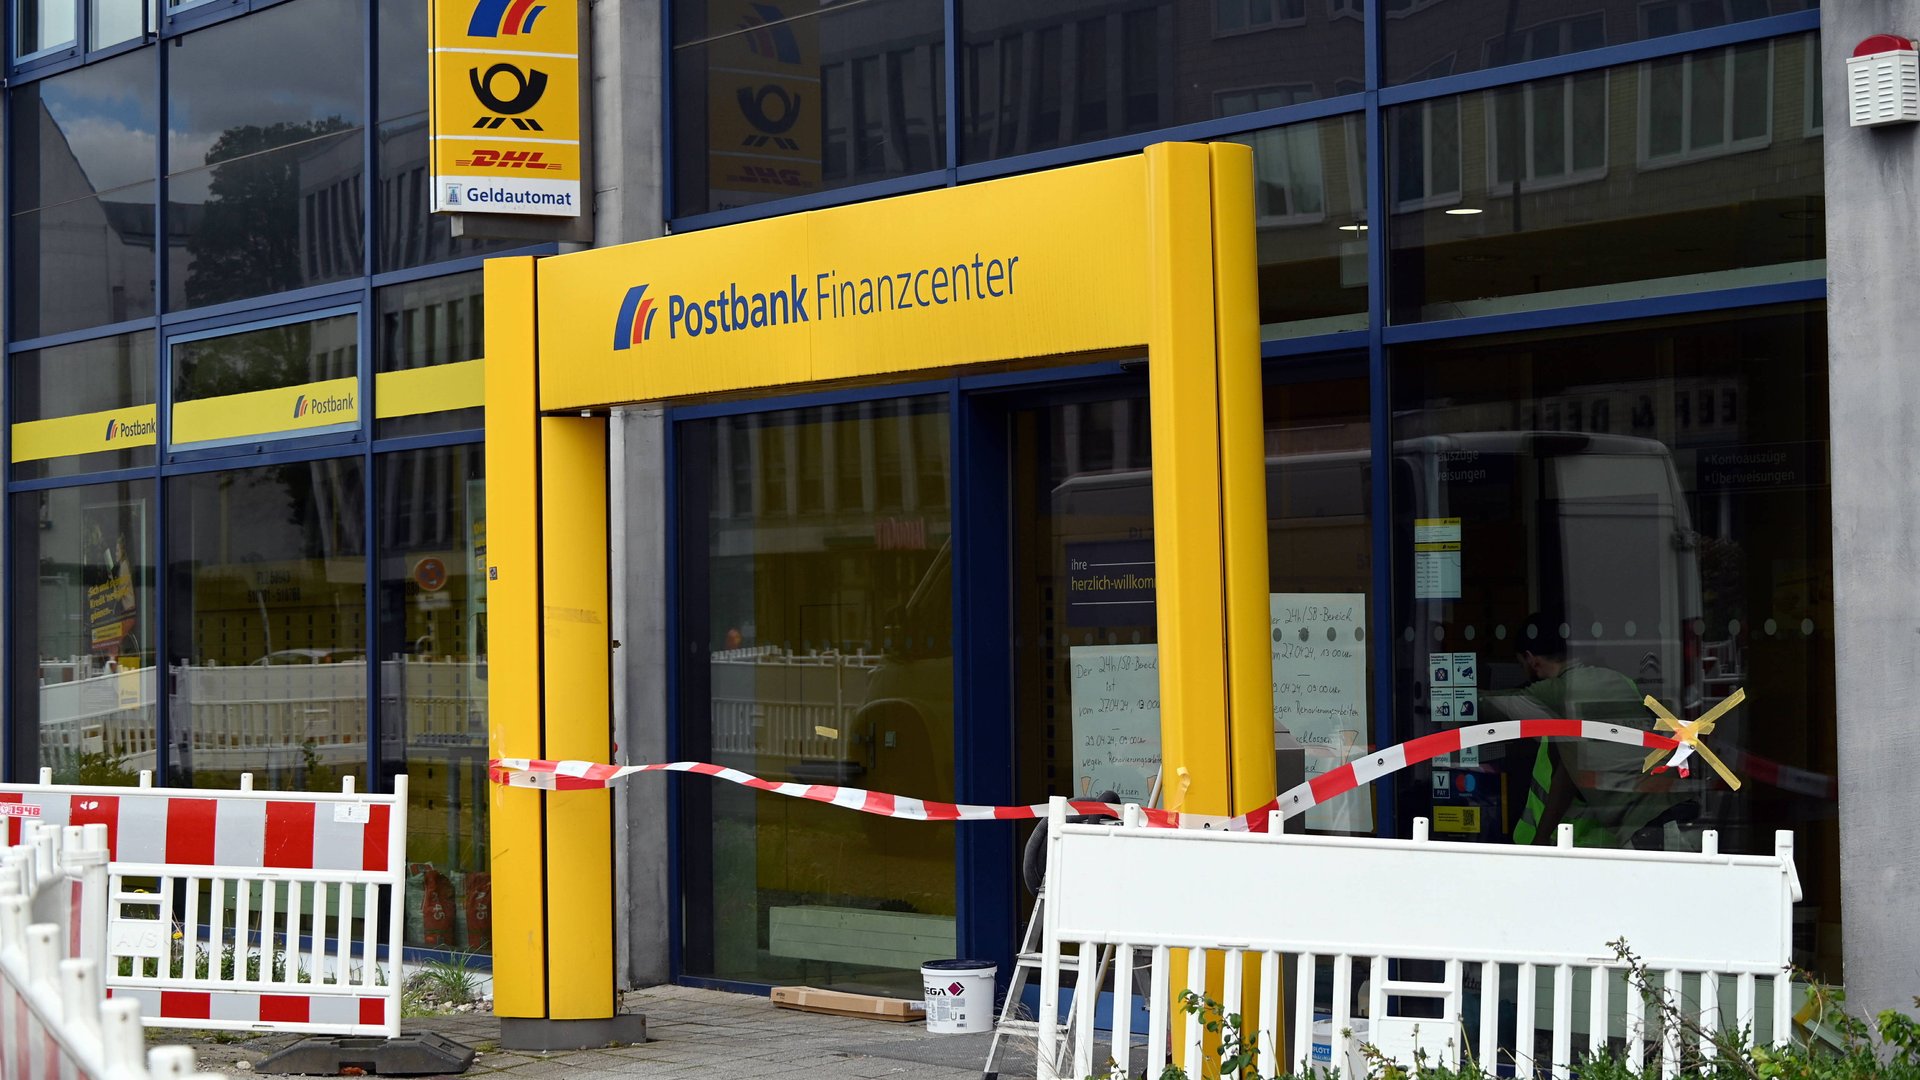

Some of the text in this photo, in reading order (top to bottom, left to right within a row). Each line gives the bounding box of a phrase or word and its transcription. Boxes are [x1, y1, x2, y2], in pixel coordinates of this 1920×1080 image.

[470, 150, 549, 169] DHL
[467, 188, 572, 205] Geldautomat
[669, 253, 1019, 339] Postbank Finanzcenter
[311, 393, 354, 415] Postbank
[119, 418, 156, 437] Postbank
[1071, 559, 1088, 570] ihre
[1076, 664, 1092, 678] Der
[1106, 678, 1116, 691] ist
[1079, 706, 1094, 716] vom
[1082, 758, 1103, 771] wegen
[10, 805, 40, 816] 1948
